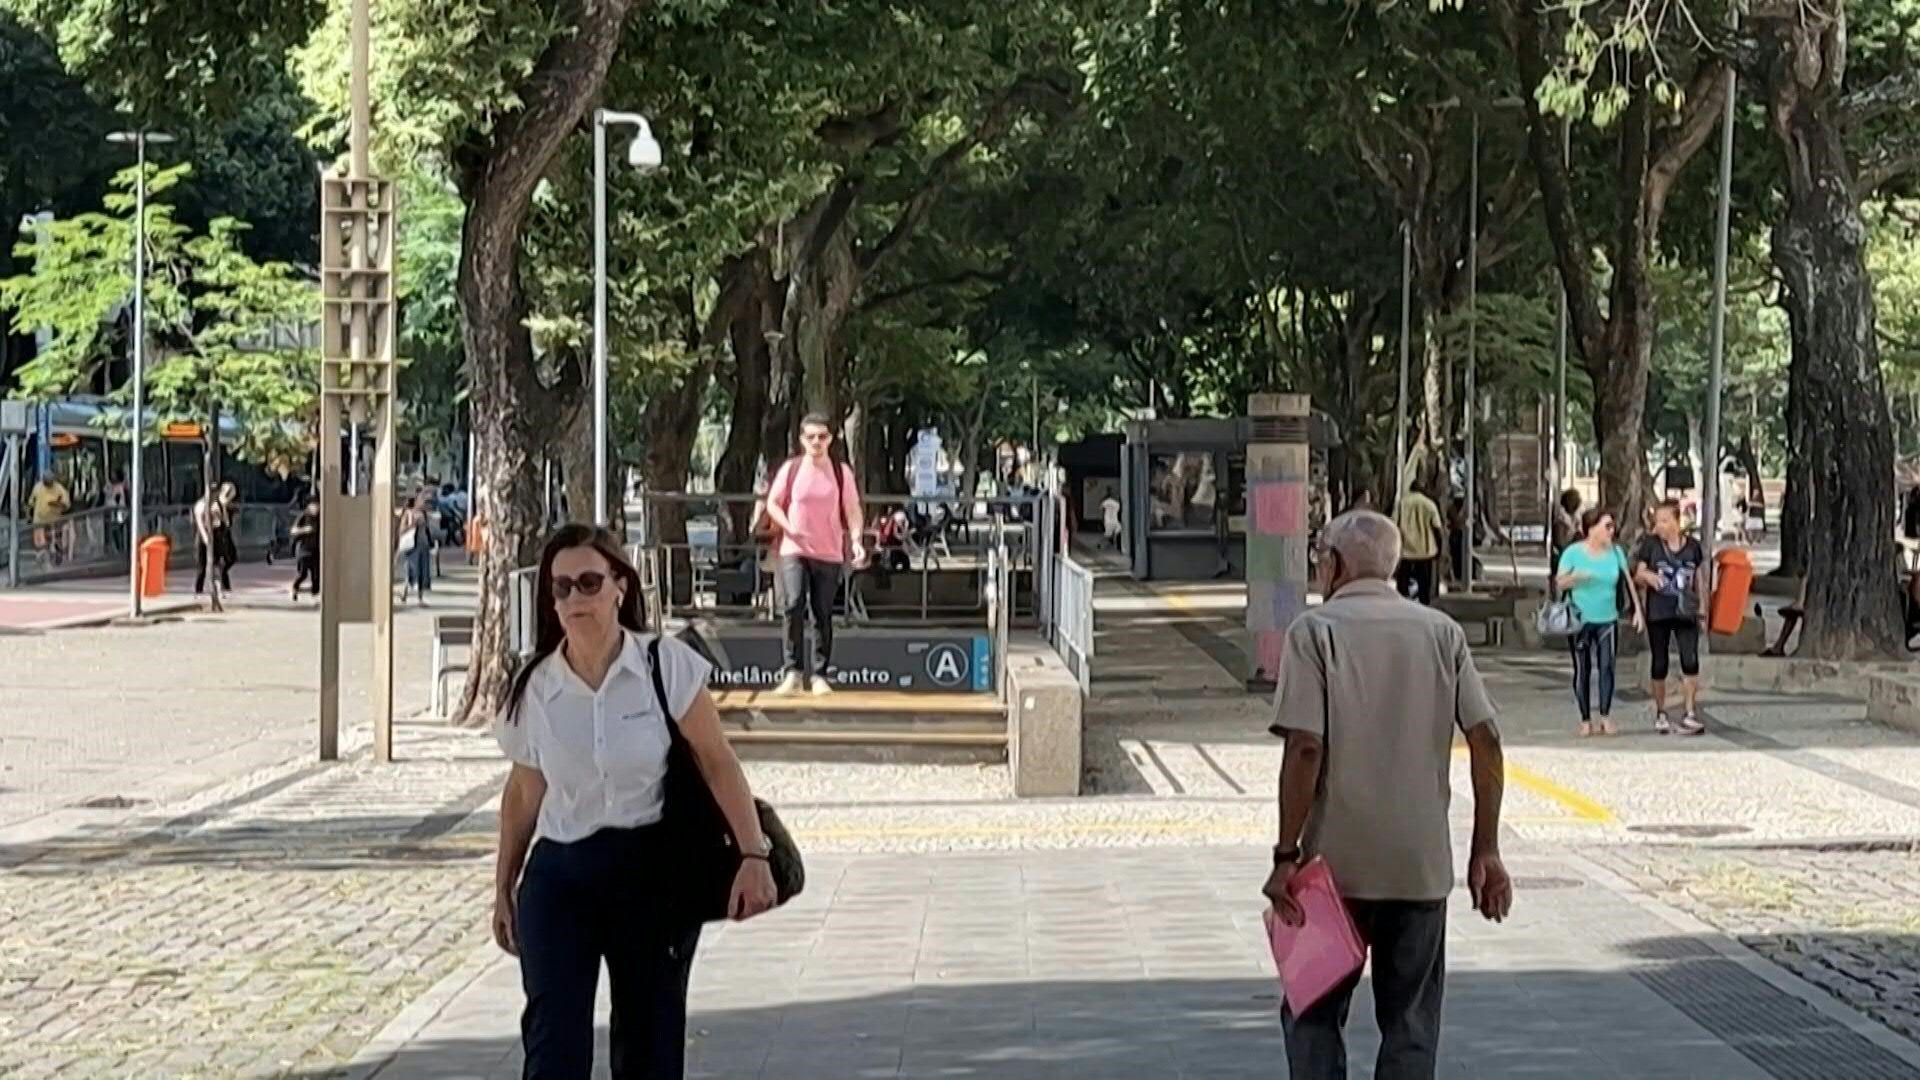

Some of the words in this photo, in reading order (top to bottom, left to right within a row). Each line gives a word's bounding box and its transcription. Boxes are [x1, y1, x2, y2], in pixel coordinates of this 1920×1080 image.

[713, 665, 785, 684] inelând
[826, 665, 890, 684] Centro
[934, 651, 960, 678] A
